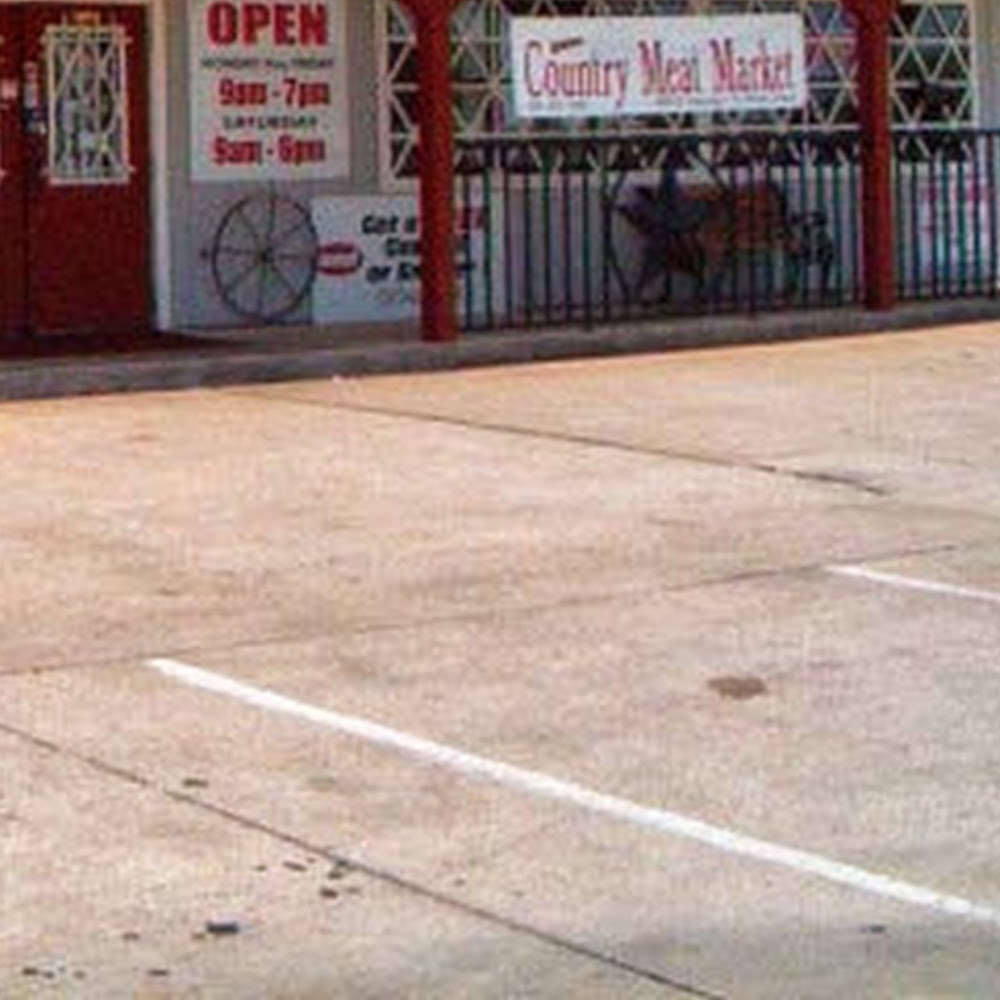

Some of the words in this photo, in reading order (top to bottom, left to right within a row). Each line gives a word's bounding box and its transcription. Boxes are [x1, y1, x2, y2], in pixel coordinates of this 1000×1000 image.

[208, 2, 329, 46] OPEN
[523, 39, 629, 107] Country
[637, 40, 701, 96] Meat
[708, 37, 794, 94] Market
[219, 77, 268, 107] 9am
[283, 77, 331, 109] 7pm
[222, 115, 319, 131] SATURDAY
